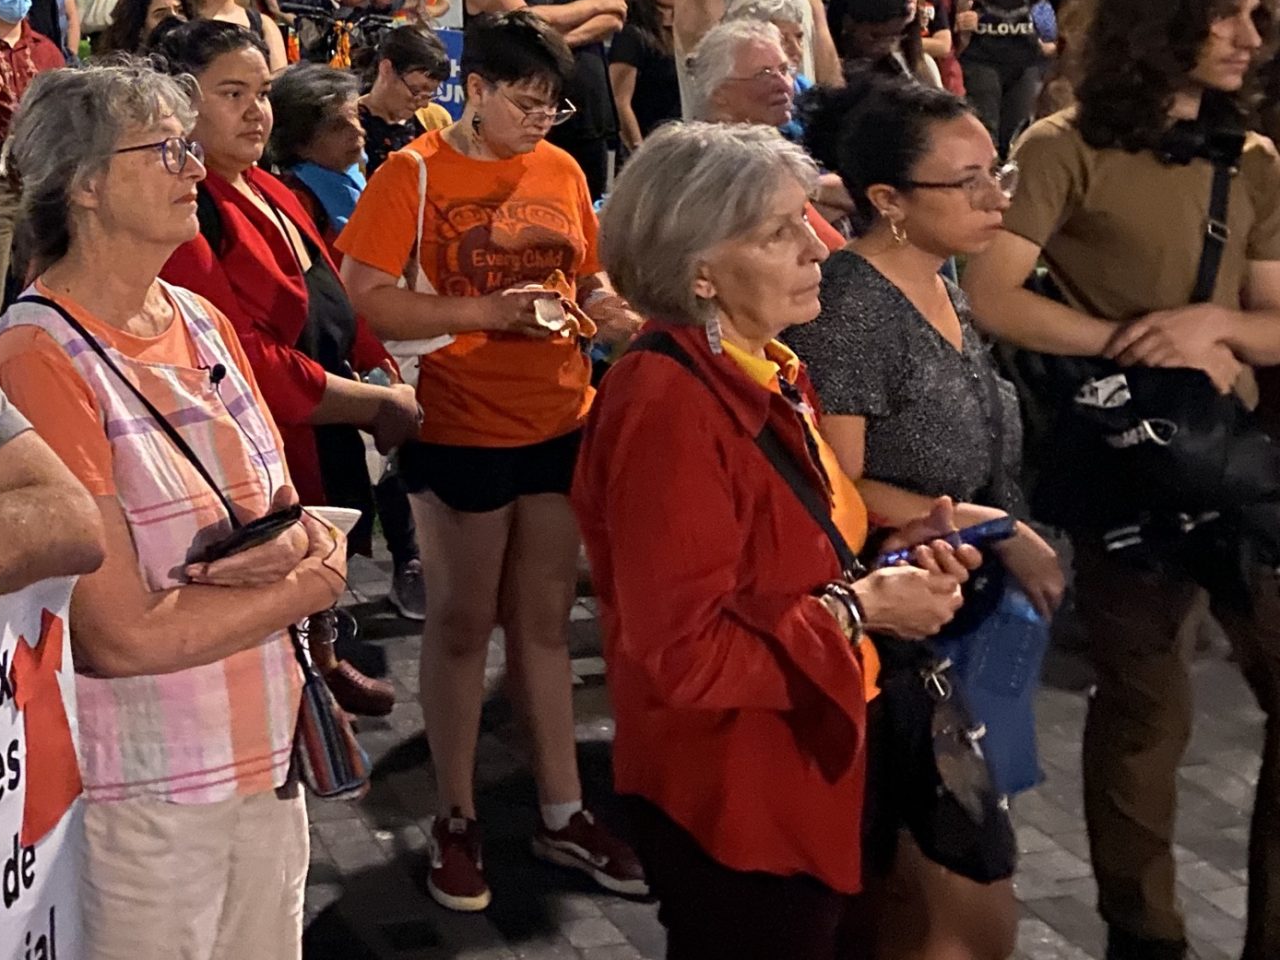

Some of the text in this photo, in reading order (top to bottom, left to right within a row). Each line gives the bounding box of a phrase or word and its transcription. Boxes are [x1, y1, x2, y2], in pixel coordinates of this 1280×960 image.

[472, 248, 564, 271] Every Child
[3, 832, 36, 909] de
